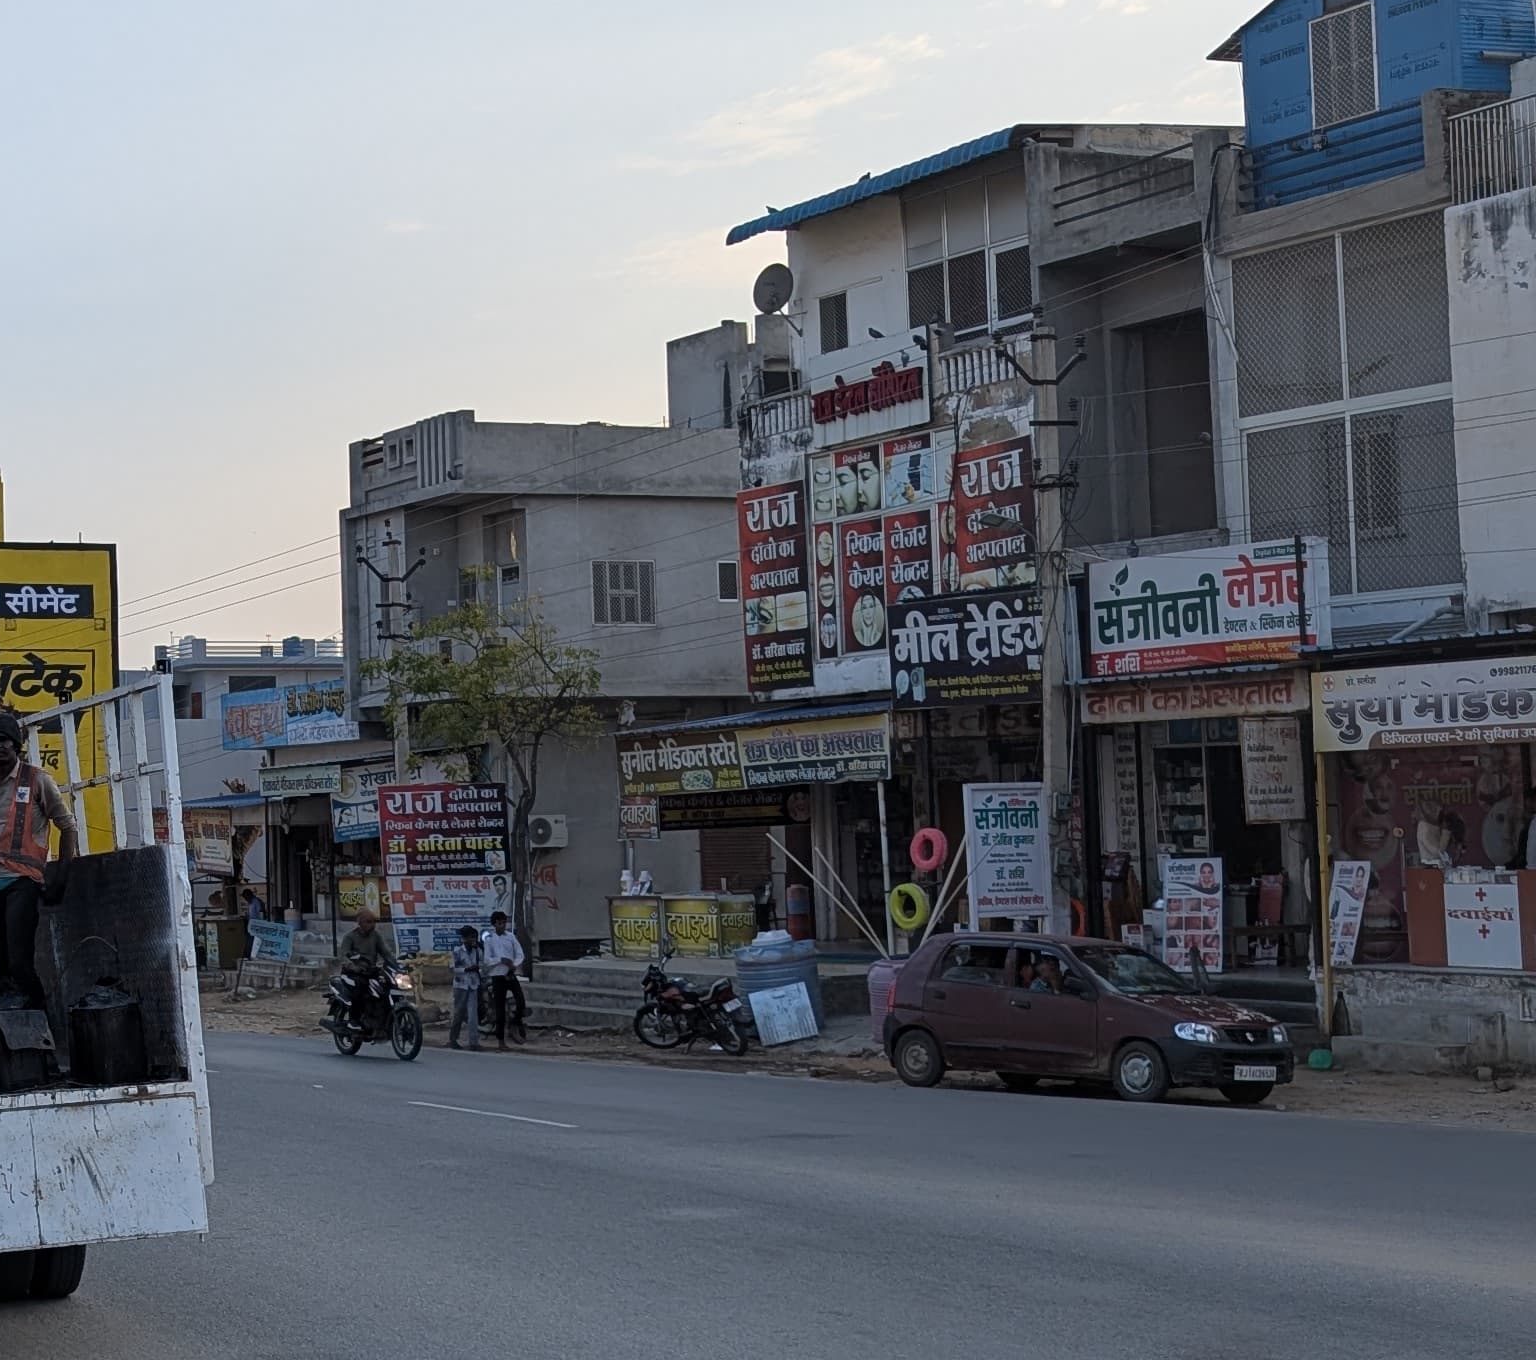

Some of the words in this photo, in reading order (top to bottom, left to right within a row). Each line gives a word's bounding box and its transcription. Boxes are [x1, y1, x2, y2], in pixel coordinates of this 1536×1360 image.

[958, 448, 1023, 497] राज
[744, 491, 799, 532] राज
[778, 539, 795, 558] का
[889, 520, 928, 549] लेजर
[966, 534, 1026, 563] अस्पताल
[750, 566, 800, 591] अस्पताल
[848, 561, 884, 589] केयर
[890, 555, 929, 584] सेन्टर
[1223, 554, 1307, 608] लेज़र
[5, 585, 80, 615] सीमेंट
[1094, 573, 1220, 645] संजीवनी
[1249, 620, 1258, 631] &
[1259, 613, 1284, 632] स्किन
[891, 610, 958, 664] मील
[1096, 653, 1112, 675] डॉ.
[1115, 651, 1141, 673] शशि
[1151, 686, 1189, 711] का
[800, 735, 820, 757] का
[1382, 729, 1423, 745] डिजिटल
[1464, 726, 1480, 742] की
[1482, 726, 1518, 744] सुविधा
[620, 741, 656, 780] सुनील
[656, 736, 709, 771] मेडिकल
[707, 732, 737, 767] स्टोर
[383, 790, 445, 815] राज
[480, 787, 499, 799] का
[447, 801, 503, 814] अस्पताल
[441, 821, 449, 830] &
[973, 801, 1039, 830] संजीवनी
[388, 834, 413, 853] डॉ.
[415, 833, 463, 852] सरिता
[464, 835, 504, 850] चाहर
